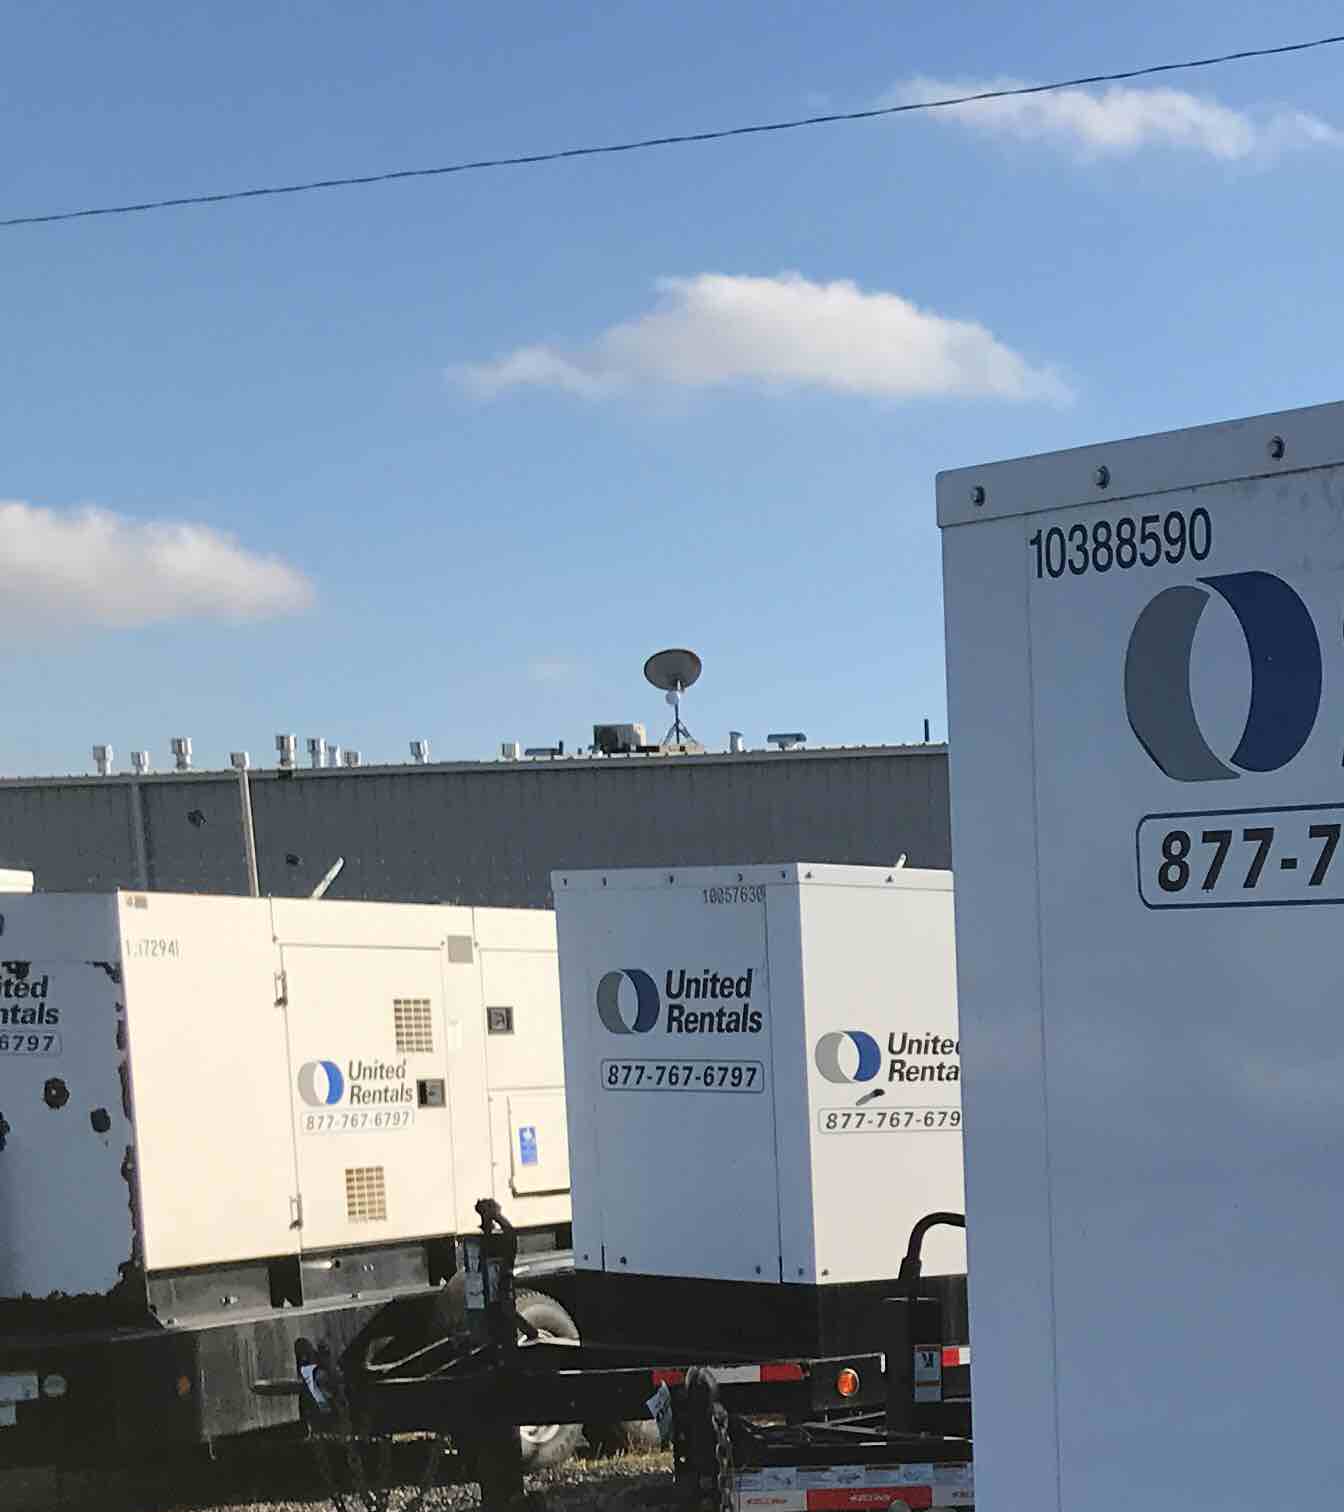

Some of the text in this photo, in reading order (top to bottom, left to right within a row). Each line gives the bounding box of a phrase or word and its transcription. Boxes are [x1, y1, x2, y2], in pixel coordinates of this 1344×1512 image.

[1029, 507, 1212, 579] 10388590
[665, 968, 753, 1000] United
[666, 1003, 763, 1034] Rentals
[348, 1058, 407, 1081] United
[607, 1064, 758, 1088] 877-767-6797
[350, 1082, 414, 1105] Rentals
